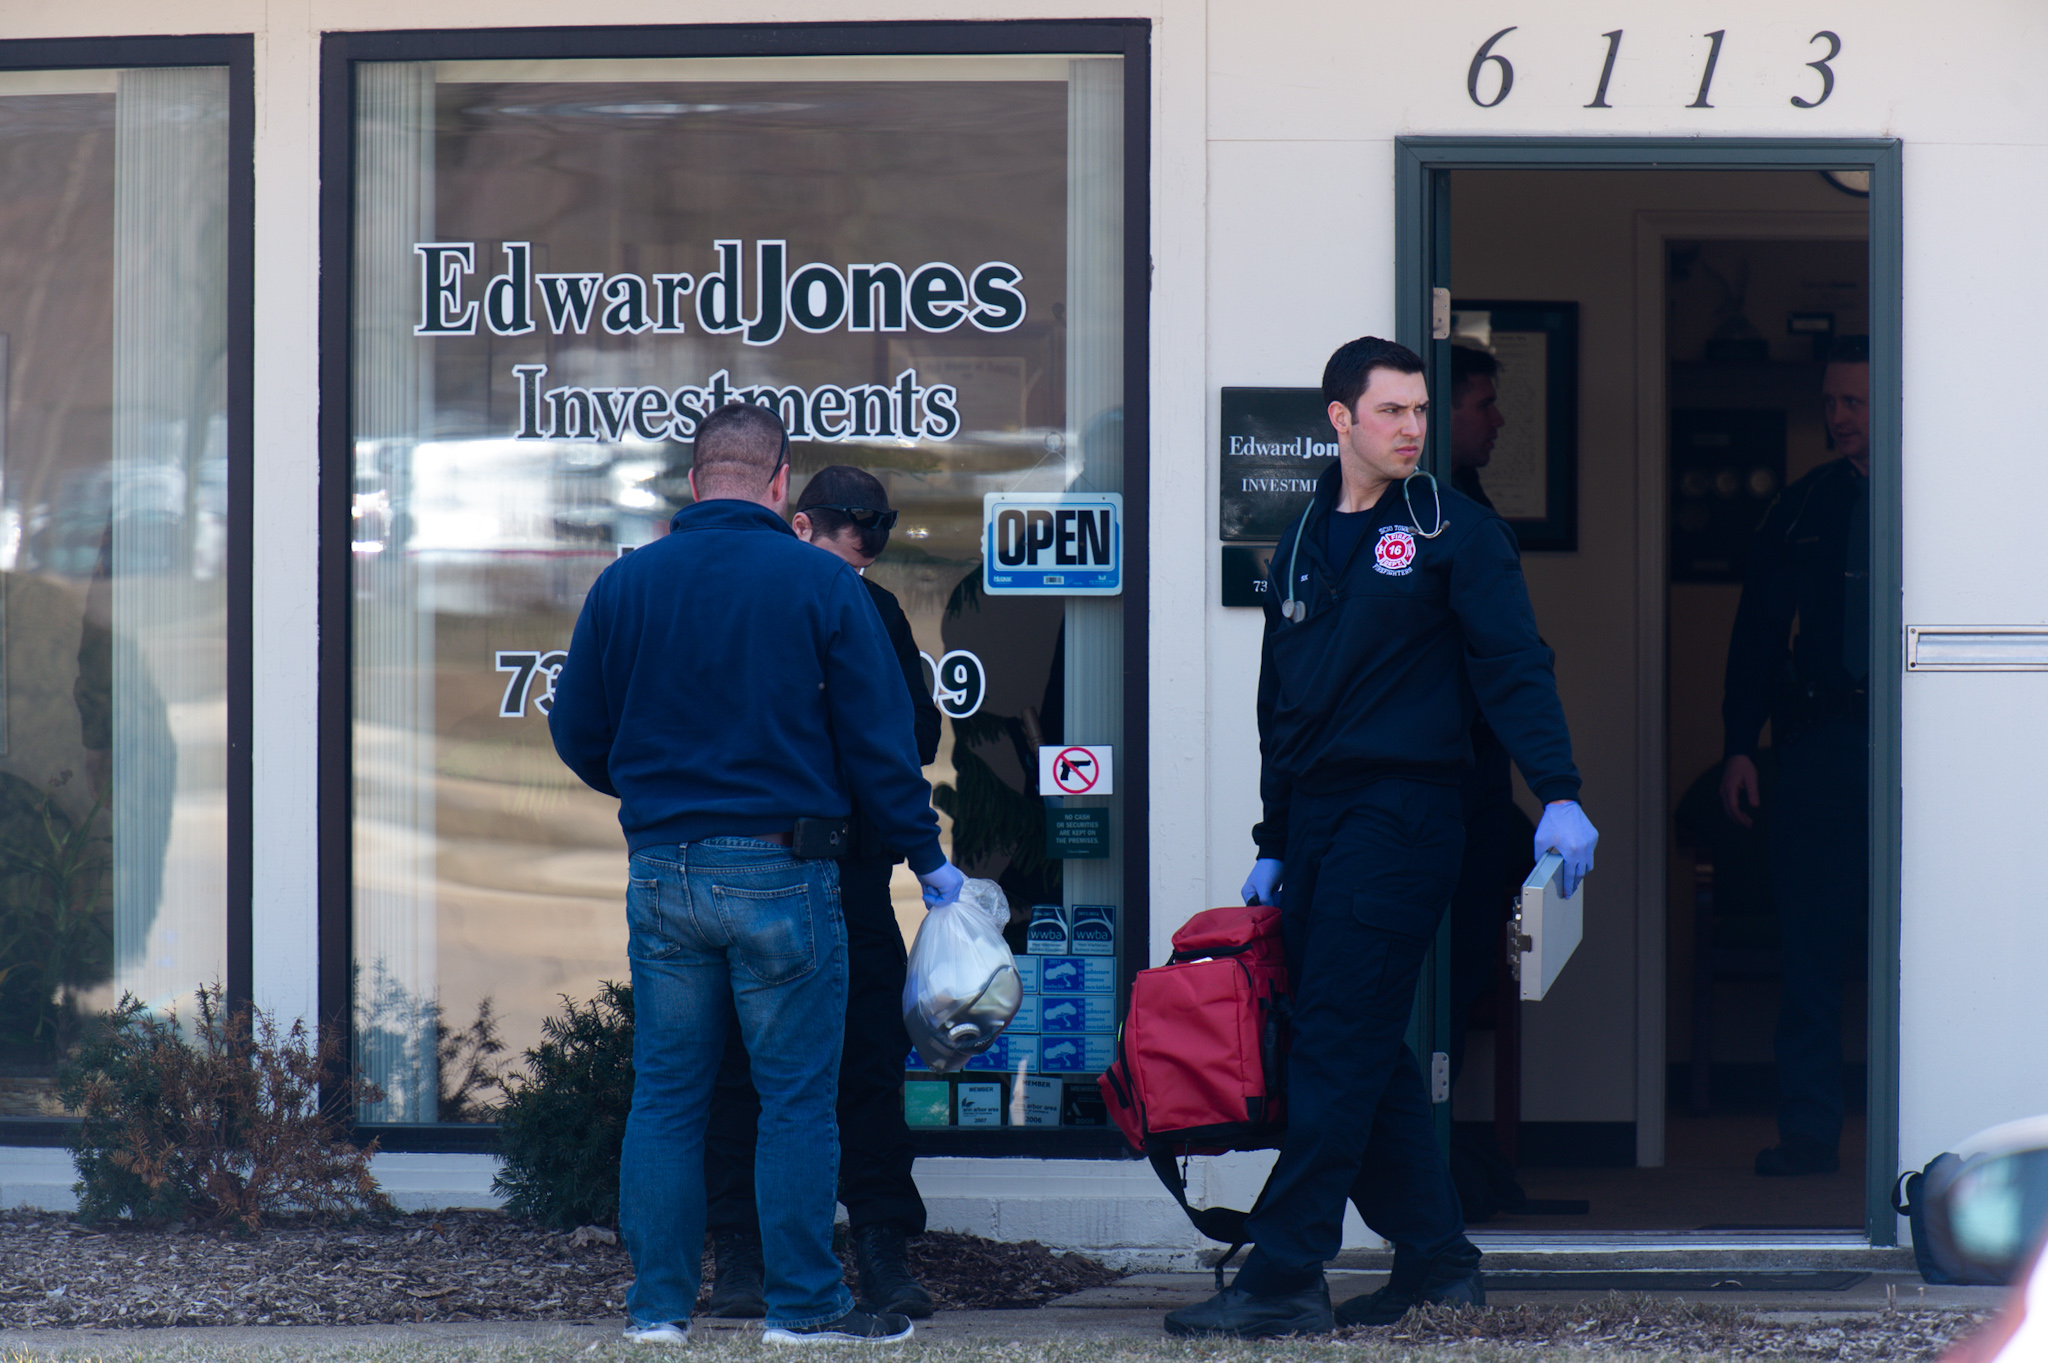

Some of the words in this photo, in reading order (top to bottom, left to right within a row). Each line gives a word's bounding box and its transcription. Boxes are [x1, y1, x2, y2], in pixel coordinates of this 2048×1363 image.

[1467, 26, 1842, 109] 6113
[1229, 435, 1339, 459] EdwardJon
[1241, 478, 1318, 492] INVESTM
[998, 510, 1110, 566] OPEN
[1389, 545, 1402, 555] 16
[495, 650, 569, 718] 73
[1030, 929, 1062, 940] wwba
[1076, 929, 1108, 940] wwba
